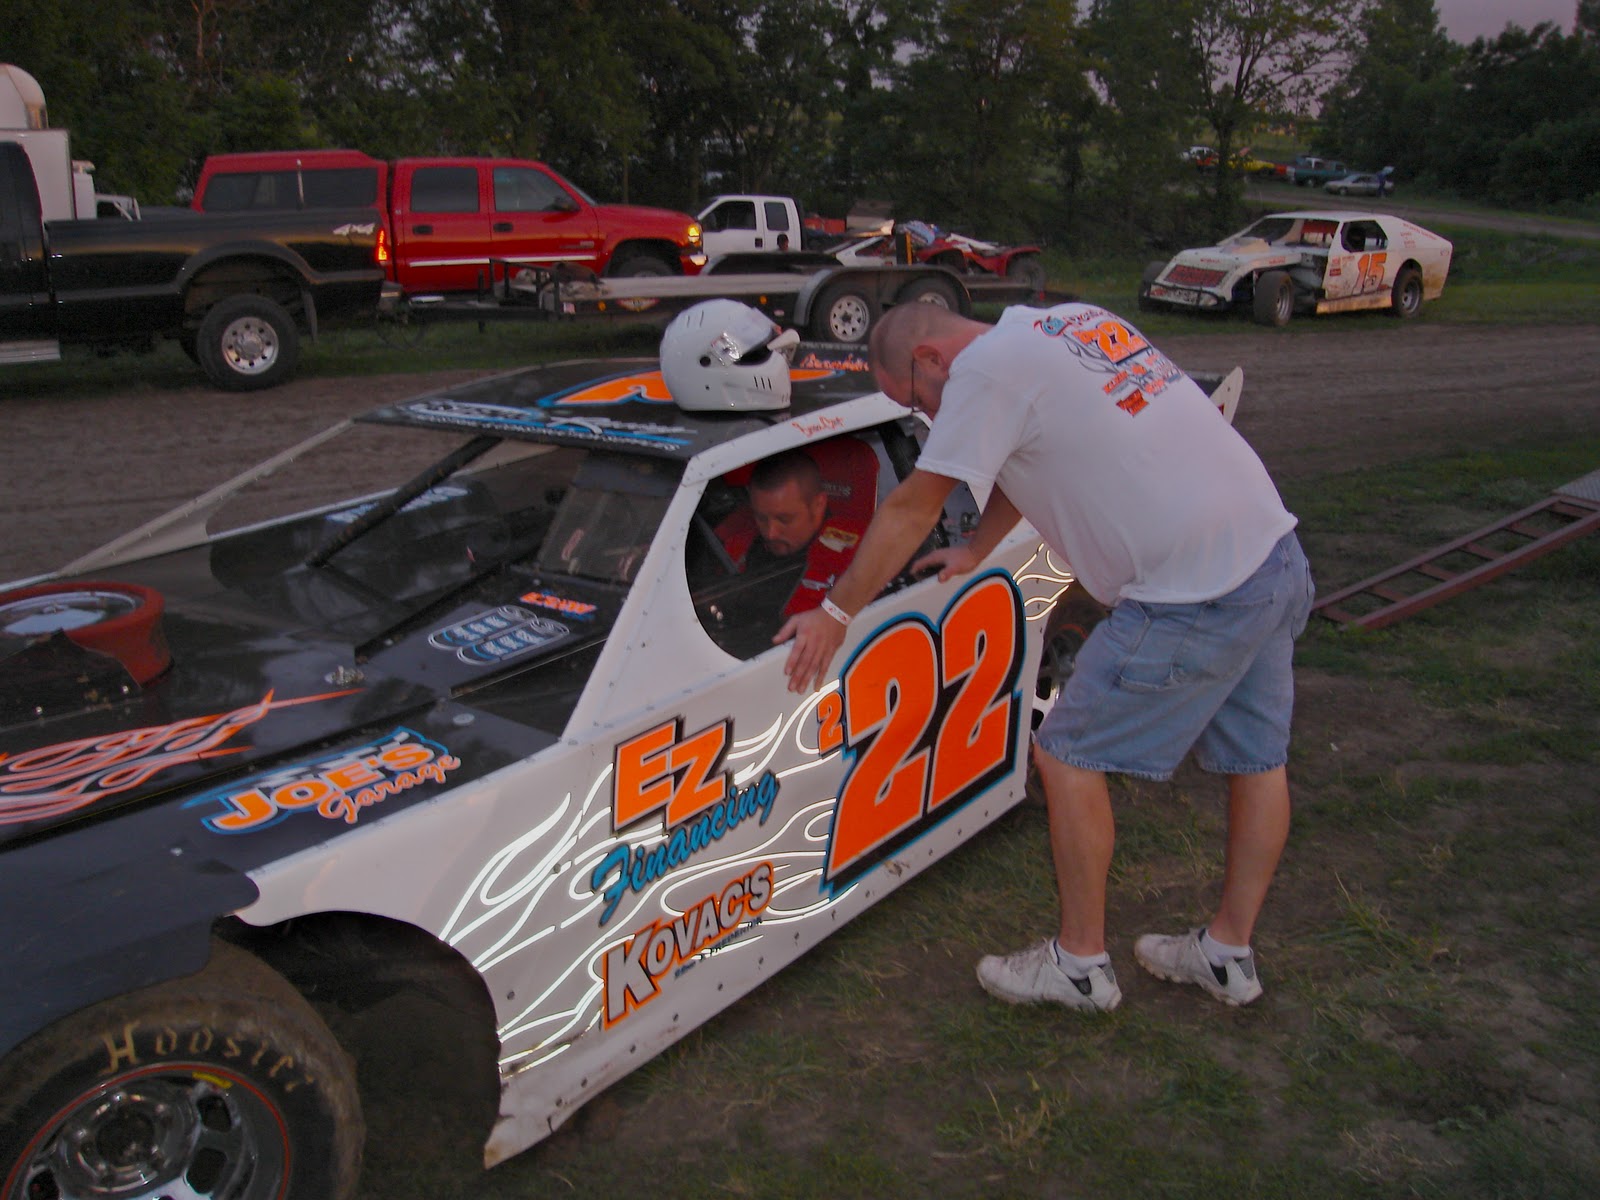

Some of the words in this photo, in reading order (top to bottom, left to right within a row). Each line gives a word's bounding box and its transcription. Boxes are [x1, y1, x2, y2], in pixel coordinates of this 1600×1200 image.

[1352, 252, 1387, 295] 15
[613, 715, 733, 833] EZ
[817, 691, 844, 757] 2
[824, 569, 1024, 889] 22
[211, 741, 435, 831] JOE'S
[590, 769, 779, 926] Financing
[603, 861, 774, 1029] KOVAC'S
